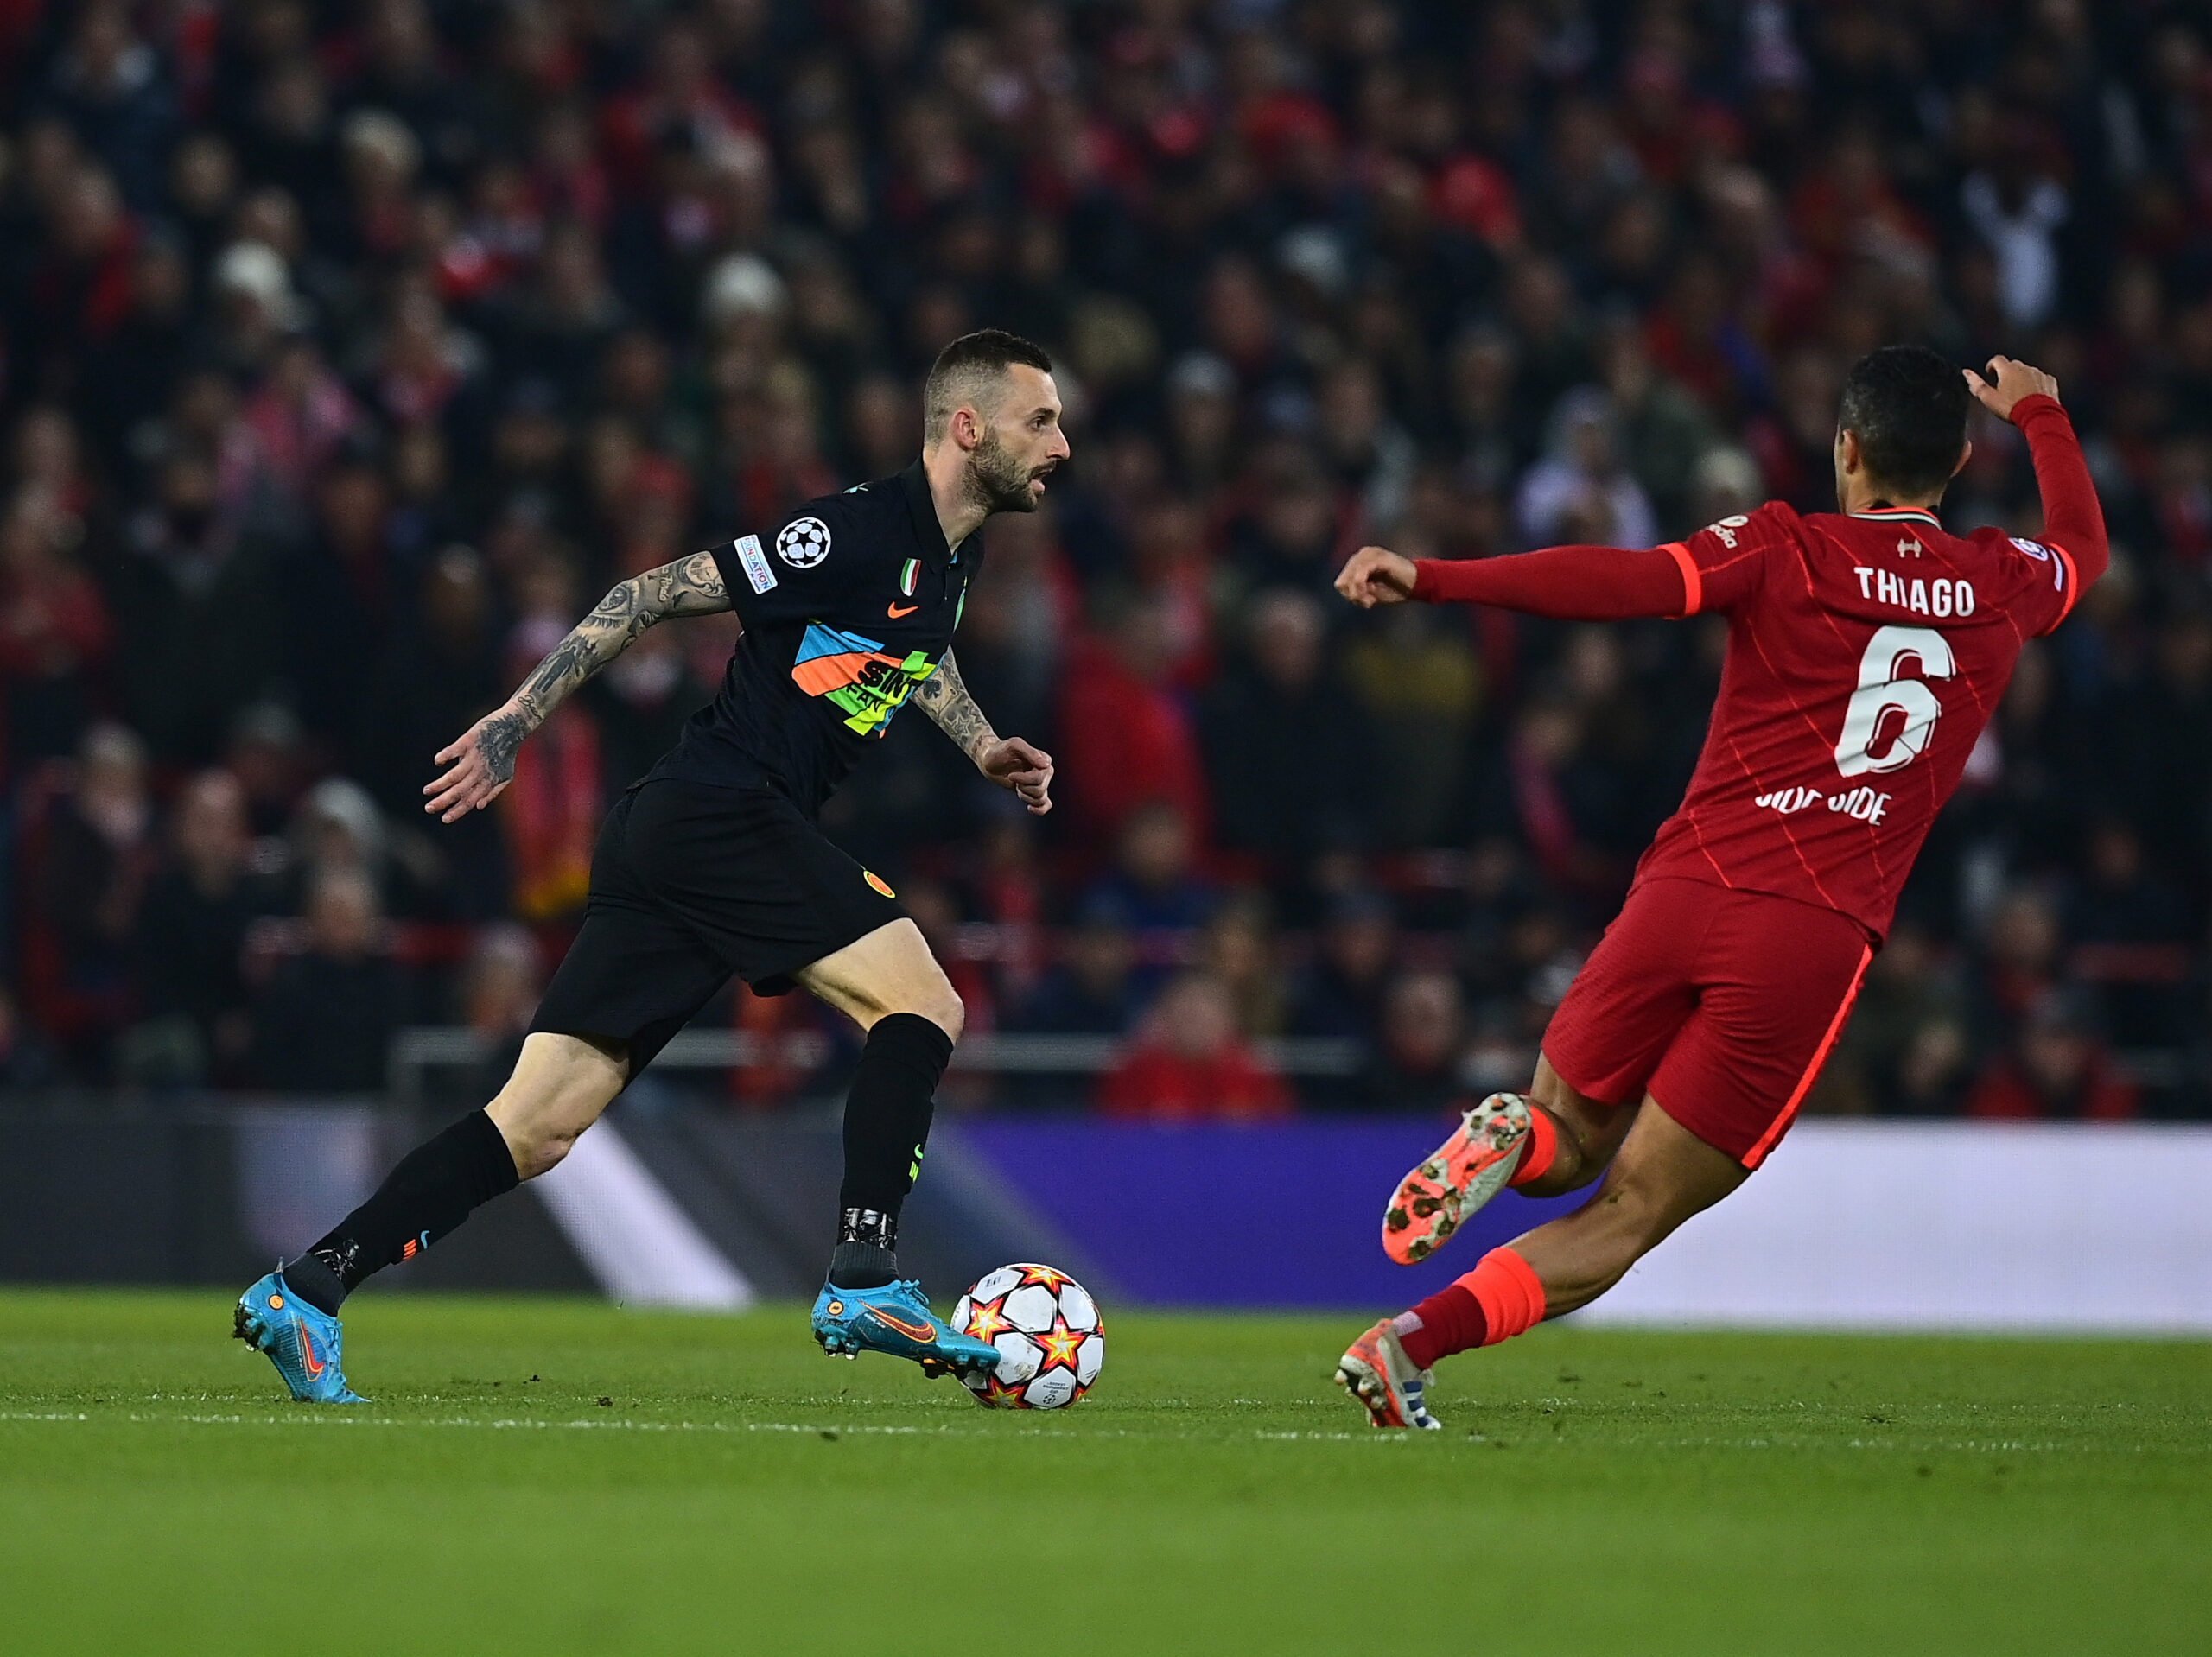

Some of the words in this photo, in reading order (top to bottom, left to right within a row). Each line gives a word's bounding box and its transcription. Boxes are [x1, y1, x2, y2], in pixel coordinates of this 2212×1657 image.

[742, 536, 771, 590] FOUNDATION
[1853, 566, 1975, 618] THIAGO
[1834, 625, 1956, 778] 6
